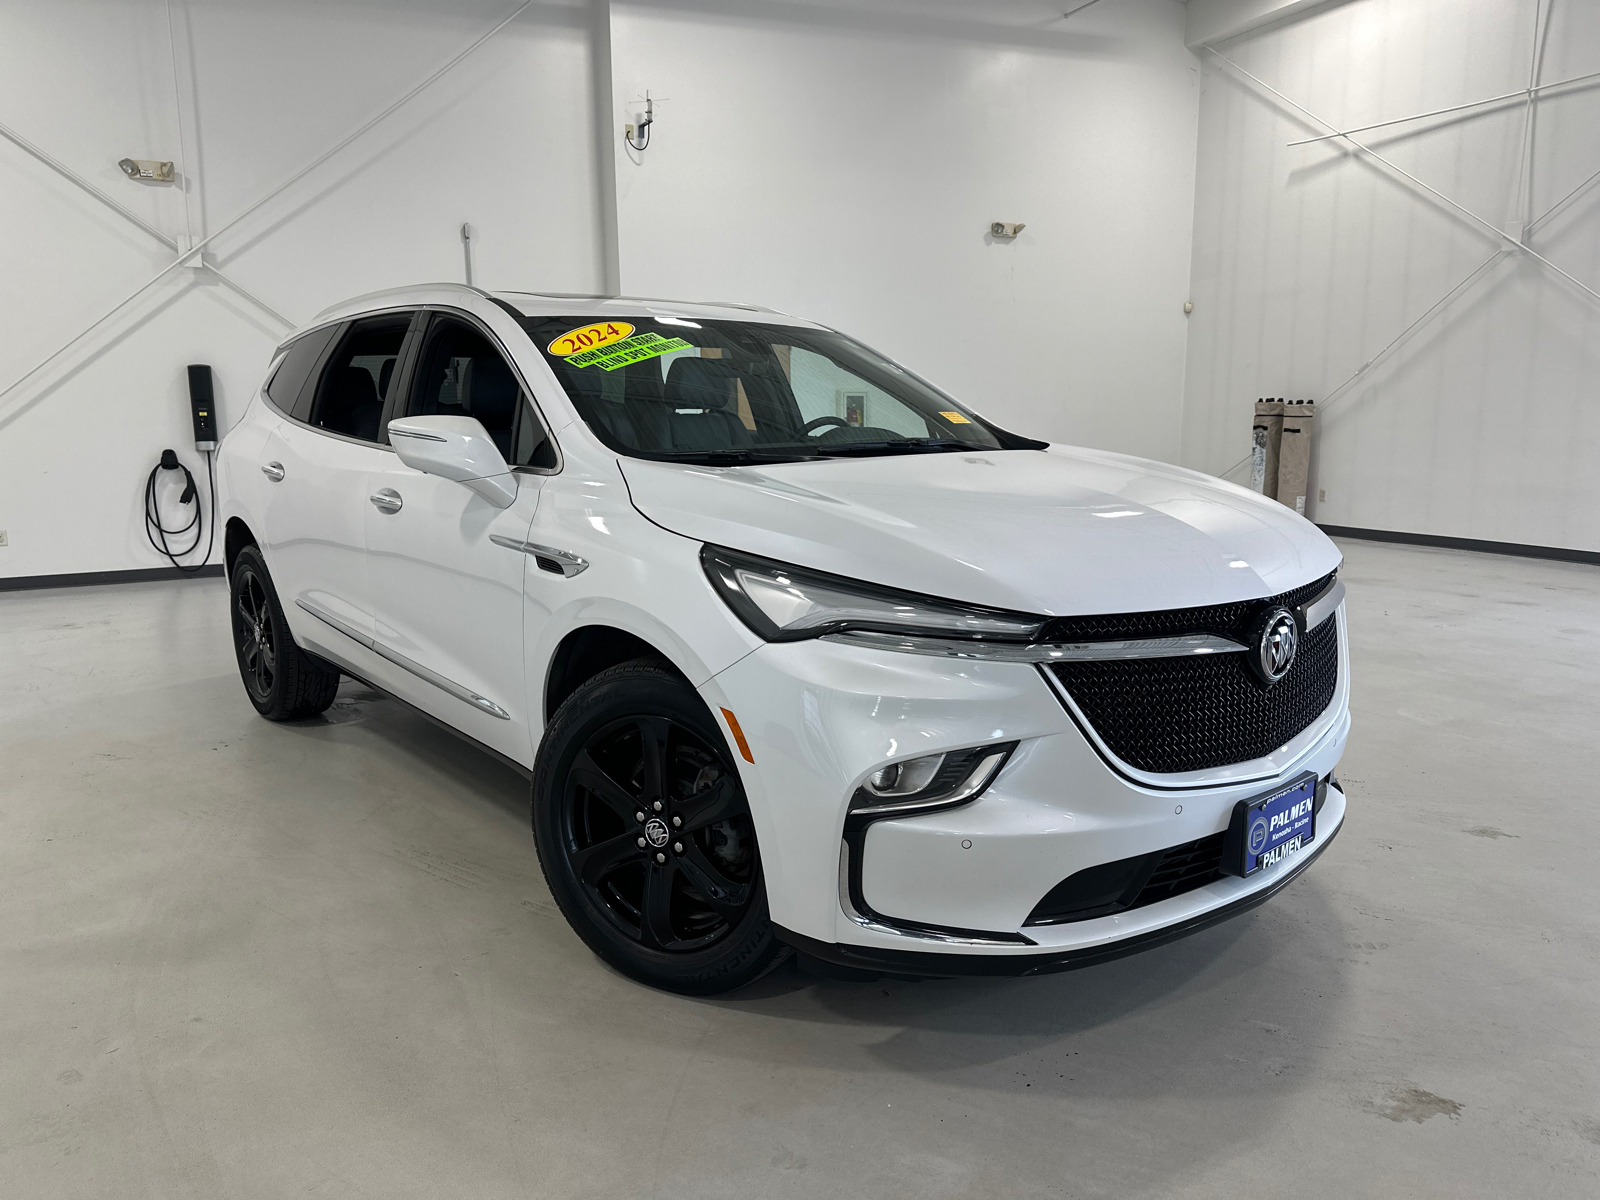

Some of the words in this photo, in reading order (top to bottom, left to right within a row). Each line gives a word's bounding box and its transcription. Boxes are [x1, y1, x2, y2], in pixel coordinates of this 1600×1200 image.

[562, 323, 620, 353] 2024
[569, 350, 604, 366] PUSH
[595, 340, 638, 357] BUTTON
[630, 333, 664, 346] START
[595, 355, 629, 369] BLIND
[624, 347, 651, 360] SPOT
[1270, 796, 1314, 832] PALMEN
[1272, 826, 1292, 841] Kenosha
[1294, 817, 1310, 830] Racine
[1262, 835, 1303, 870] PALMEN
